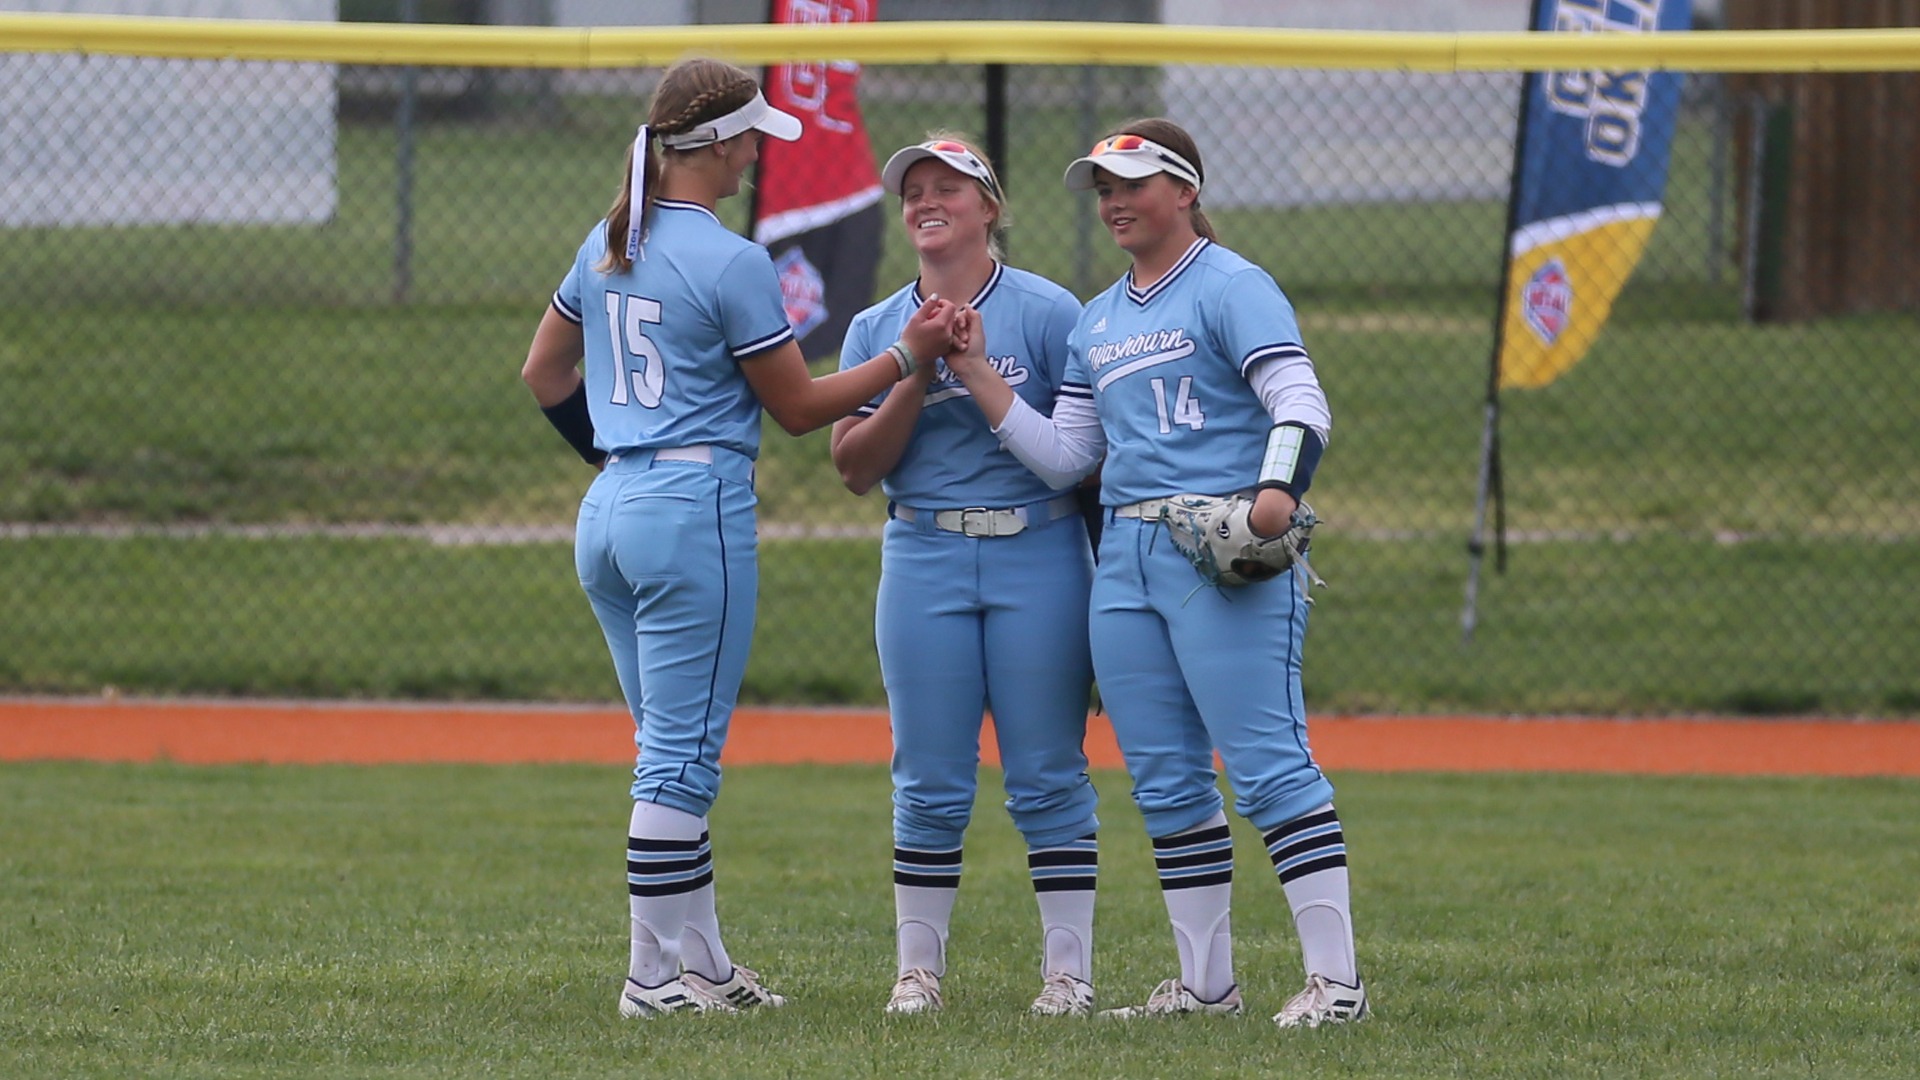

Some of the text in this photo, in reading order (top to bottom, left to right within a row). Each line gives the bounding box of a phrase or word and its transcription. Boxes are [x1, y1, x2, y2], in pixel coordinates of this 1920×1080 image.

[605, 290, 666, 409] 15
[1088, 327, 1185, 373] Washburn
[1150, 376, 1205, 434] 14
